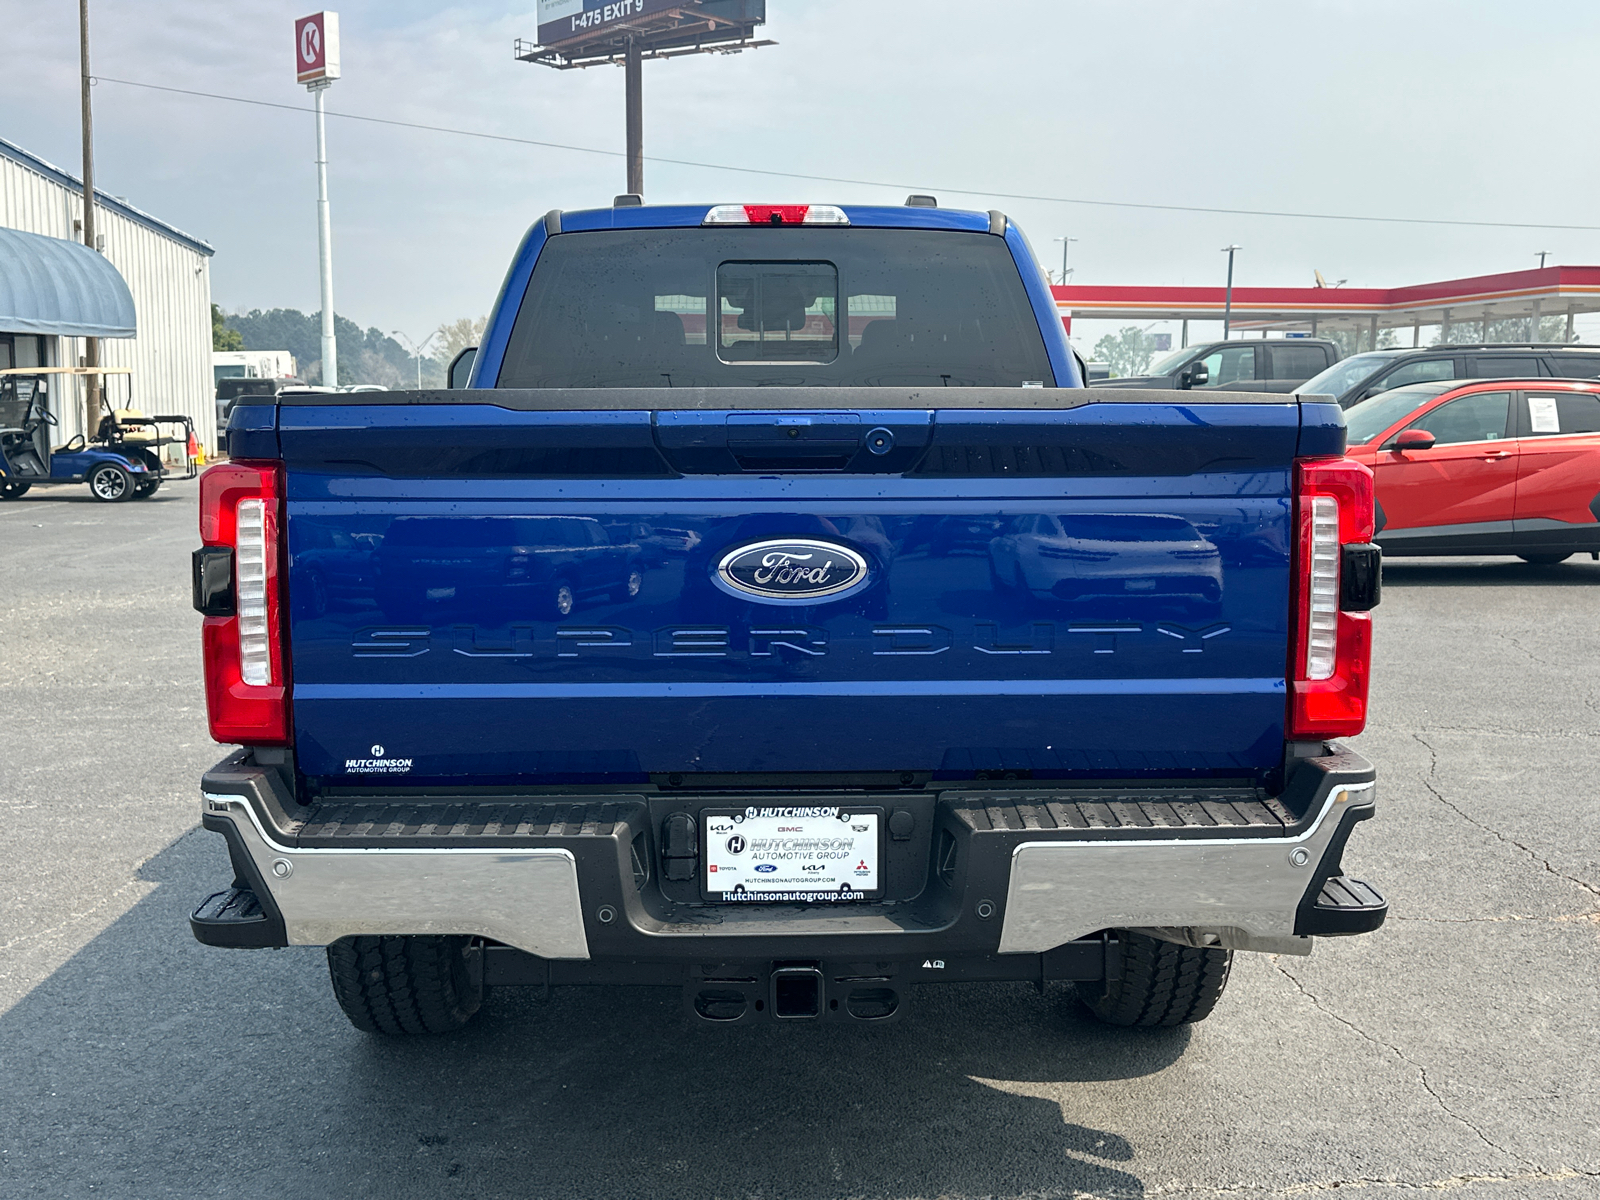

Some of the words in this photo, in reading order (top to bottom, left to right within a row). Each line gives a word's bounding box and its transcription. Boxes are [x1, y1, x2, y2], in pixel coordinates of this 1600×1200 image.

[571, 9, 601, 31] I-475
[604, 0, 632, 21] EXIT
[635, 0, 643, 12] 9
[305, 28, 318, 59] K
[754, 552, 832, 584] Ford
[352, 625, 829, 657] SUPER
[872, 622, 1231, 655] DUTY
[345, 759, 412, 768] HUTCHINSON
[759, 806, 839, 818] HUTCHINSON
[750, 838, 854, 851] HUTCHINSON
[751, 851, 814, 860] AUTOMOTIVE
[816, 851, 850, 860] GROUP
[722, 890, 864, 902] Hutchinsonautogroup.com
